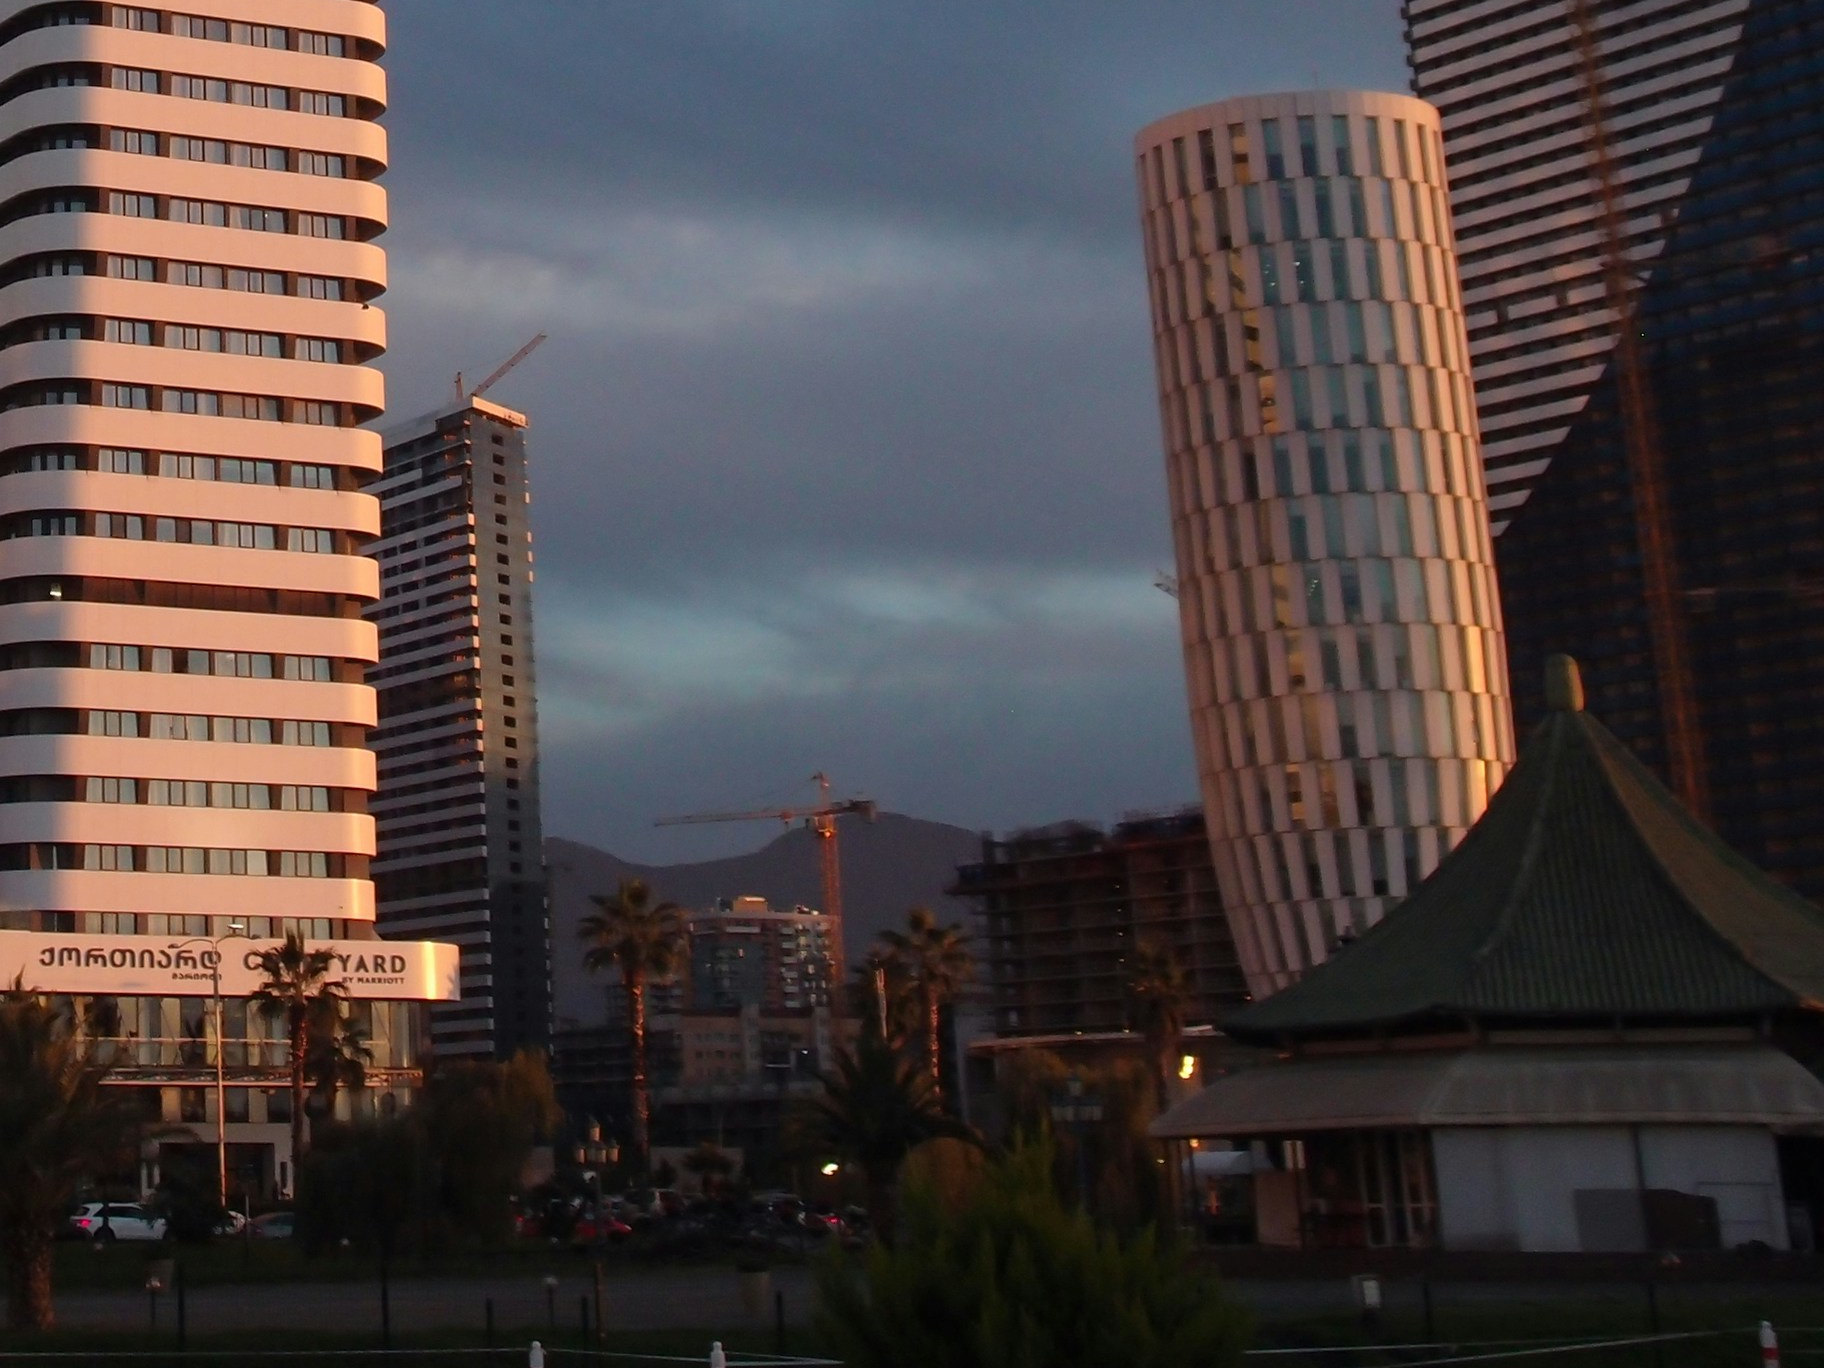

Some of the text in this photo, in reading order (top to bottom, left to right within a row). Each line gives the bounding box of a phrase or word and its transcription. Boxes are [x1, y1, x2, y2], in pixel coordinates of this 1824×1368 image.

[243, 951, 406, 974] CYARD
[342, 977, 405, 985] BY MARRIOTT
